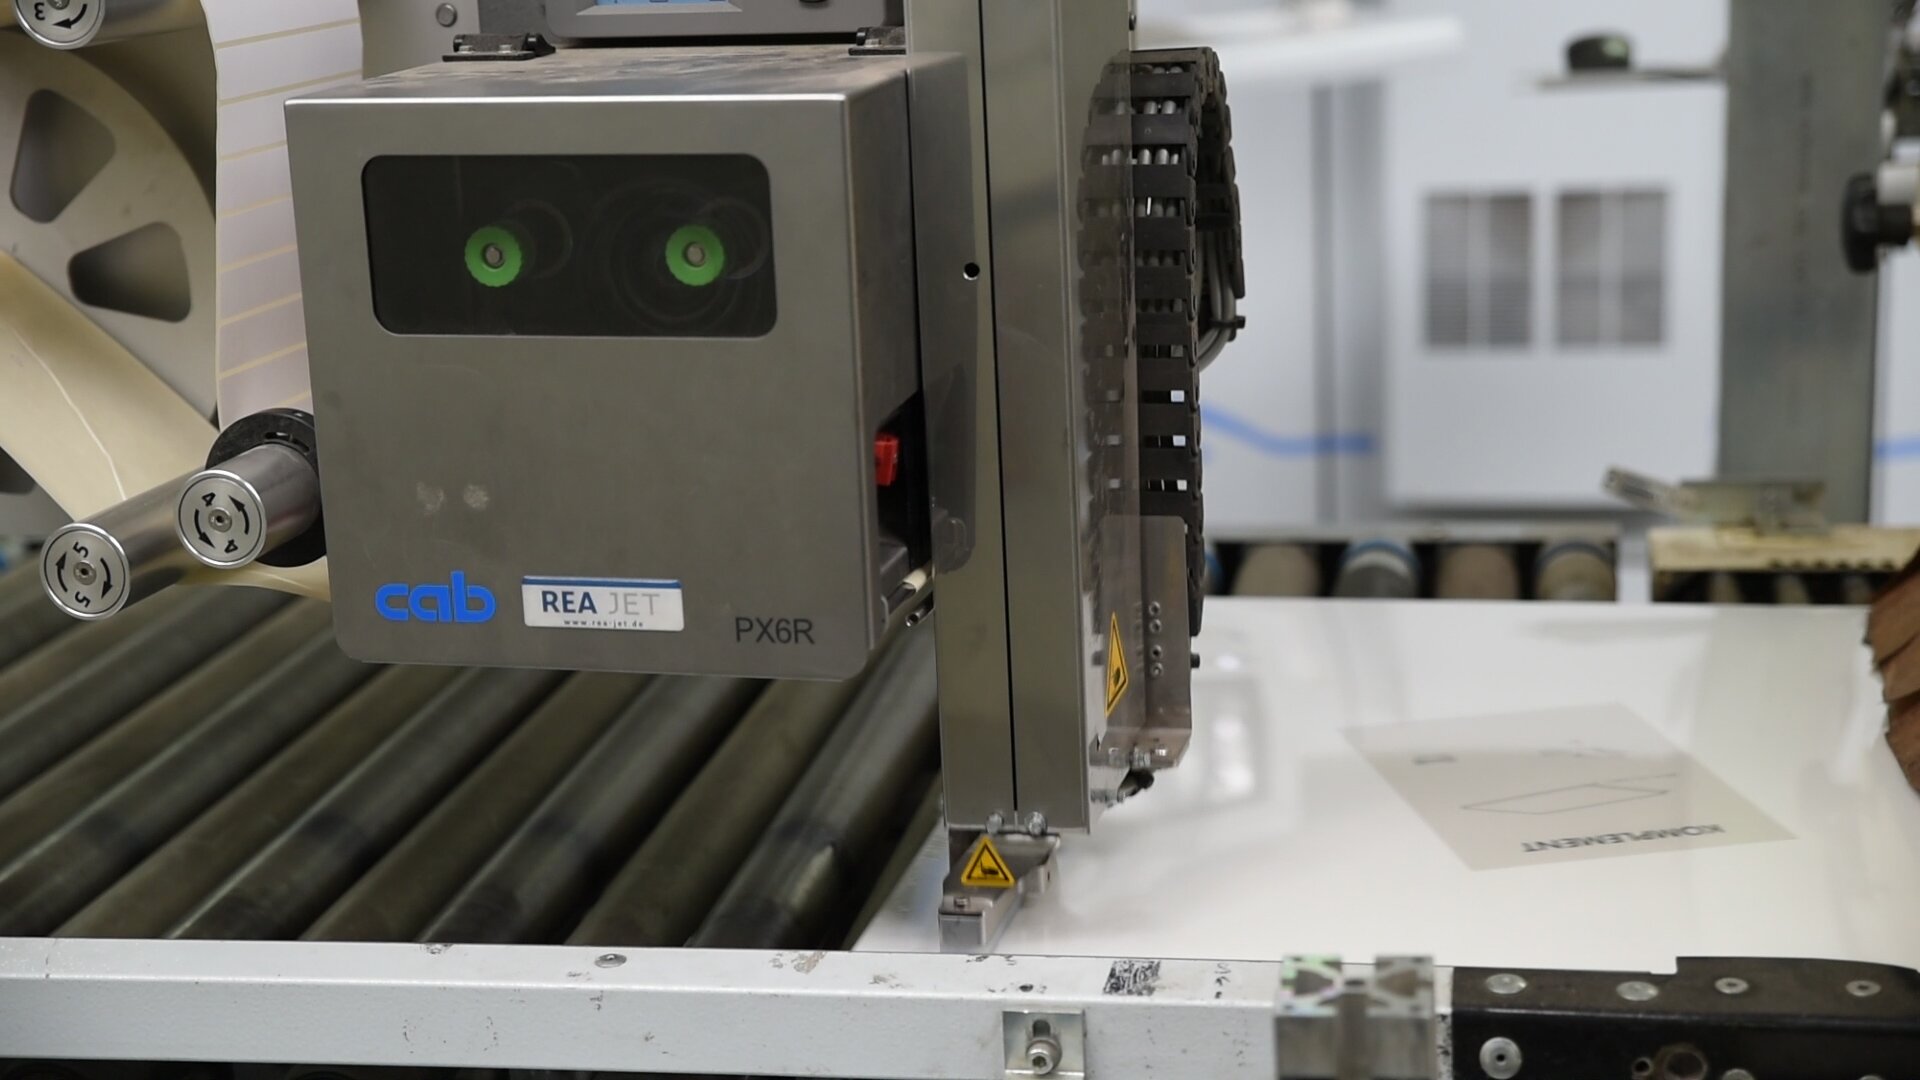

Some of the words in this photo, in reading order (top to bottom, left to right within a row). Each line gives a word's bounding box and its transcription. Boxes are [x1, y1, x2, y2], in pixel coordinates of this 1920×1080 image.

[34, 2, 45, 20] 3
[202, 492, 215, 507] 4
[73, 541, 87, 558] 5
[225, 539, 238, 554] 4
[75, 591, 90, 608] 5
[375, 570, 496, 623] cab
[541, 590, 597, 614] REA
[608, 592, 660, 616] JET
[563, 619, 643, 628] www.rea-jet.de
[735, 617, 815, 644] PX6R
[1522, 824, 1725, 852] KOMPLEMENT
